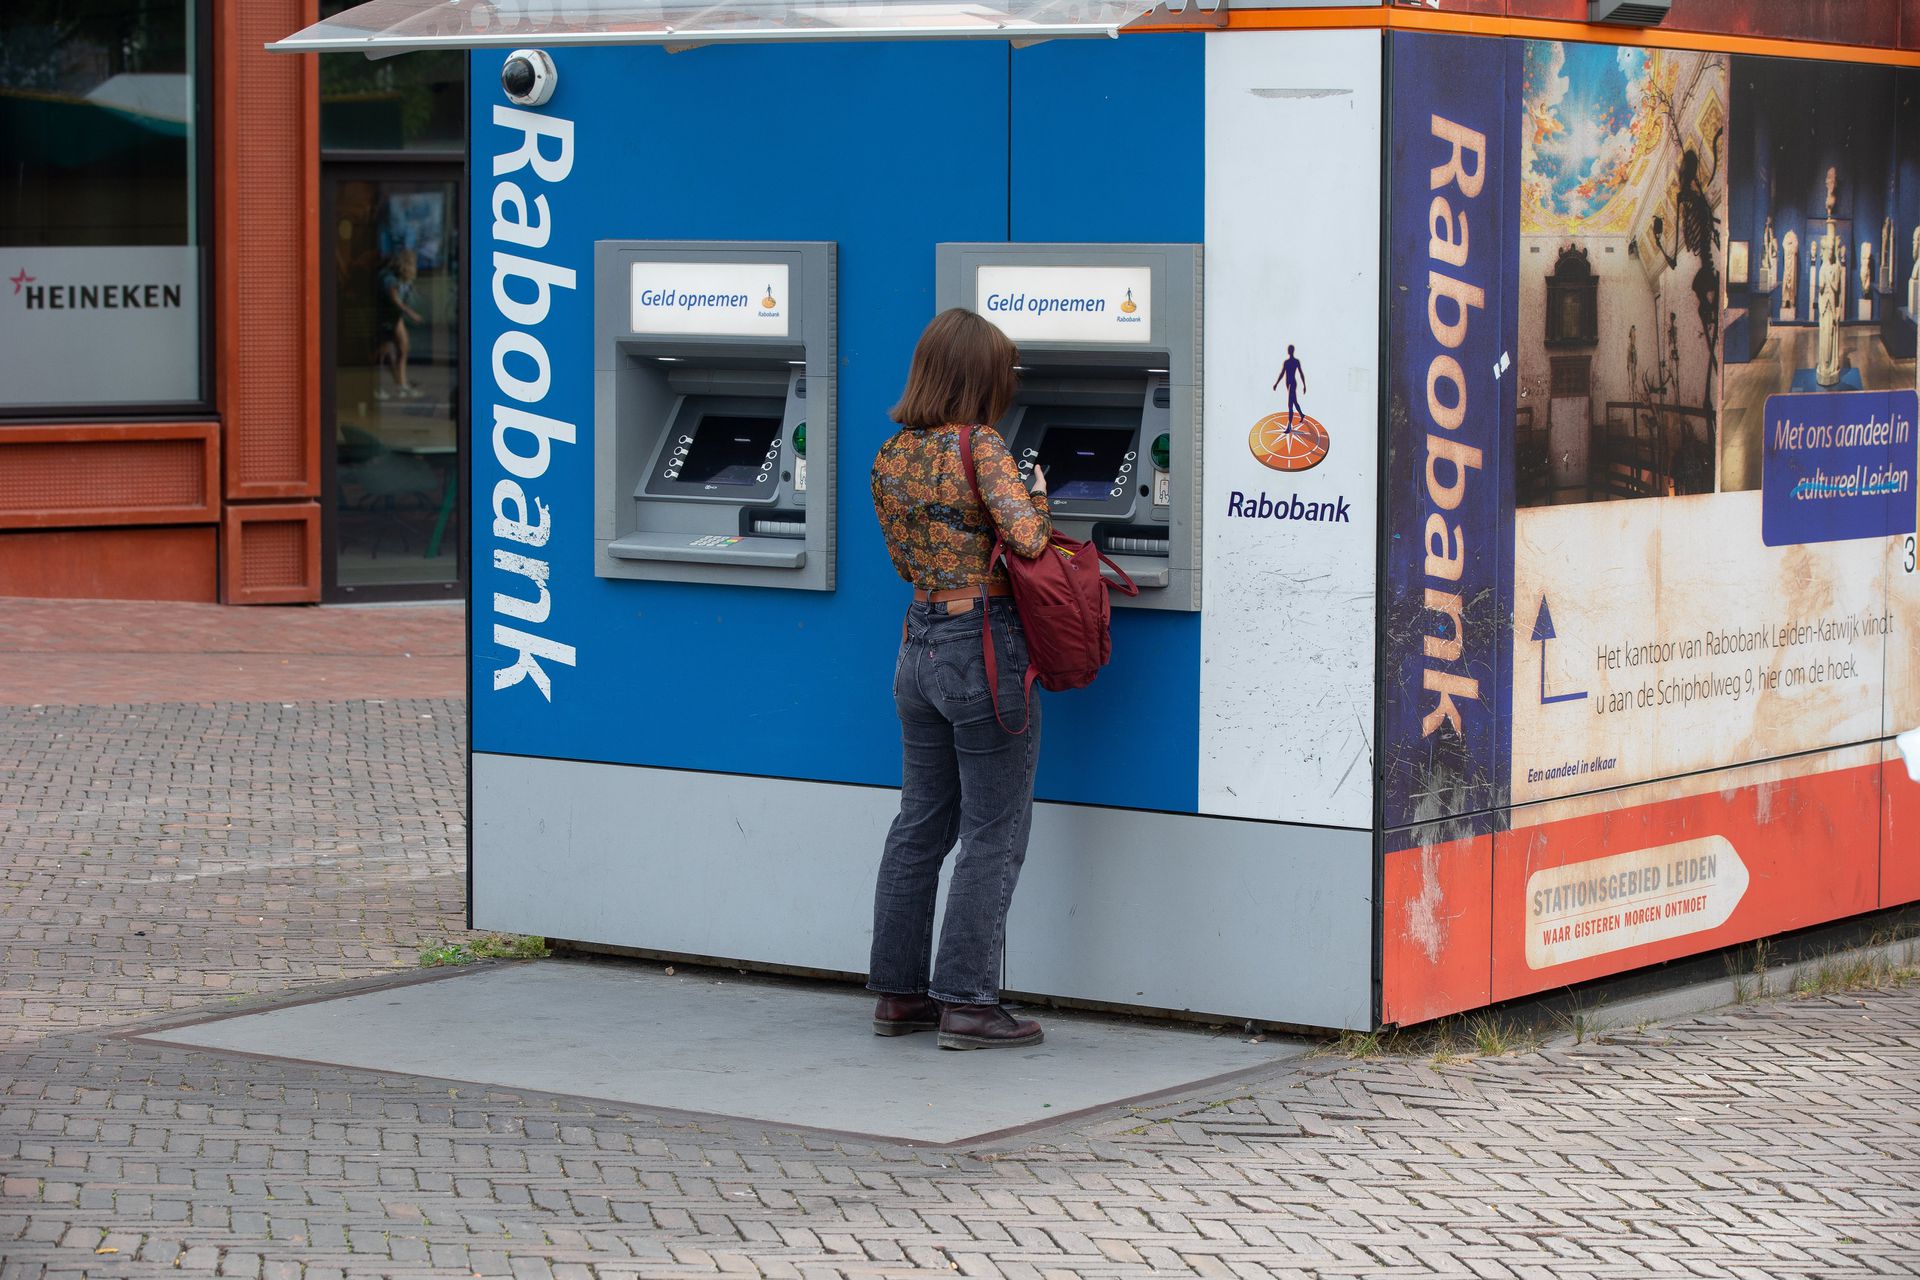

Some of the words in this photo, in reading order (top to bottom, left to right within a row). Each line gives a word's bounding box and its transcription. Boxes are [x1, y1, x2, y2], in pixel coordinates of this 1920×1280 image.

[26, 284, 182, 309] HEINEKEN
[641, 289, 676, 307] Geld
[678, 294, 748, 311] opnemen
[987, 293, 1025, 312] Geld
[1028, 298, 1106, 316] opnemen
[492, 104, 577, 703] Rabobank
[1421, 113, 1487, 738] Rabobank
[1774, 419, 1804, 450] Met
[1806, 424, 1833, 449] ons
[1835, 412, 1894, 448] aandeel
[1895, 413, 1909, 443] in
[1796, 464, 1860, 500] cultureel
[1861, 462, 1908, 496] Leiden
[1227, 491, 1350, 523] Rabobank
[1904, 536, 1916, 573] 3
[1597, 644, 1621, 671] Het
[1625, 640, 1676, 667] kantoor
[1679, 639, 1702, 659] van
[1706, 623, 1769, 657] Rabobank
[1772, 613, 1859, 648] Leiden-Katwijk
[1861, 609, 1894, 637] vindt
[1596, 695, 1605, 715] u
[1608, 690, 1633, 713] aan
[1637, 681, 1654, 708] de
[1656, 671, 1741, 708] Schipholweg
[1744, 668, 1755, 696] 9,
[1758, 664, 1782, 691] hier
[1784, 667, 1806, 687] om
[1808, 658, 1824, 684] de
[1827, 653, 1859, 681] hoek.
[1527, 768, 1544, 783] Een
[1545, 760, 1580, 780] aandeel
[1580, 759, 1589, 774] in
[1590, 757, 1617, 772] elkaar
[1533, 866, 1661, 917] STATIONSGEBIED
[1666, 853, 1717, 888] LEIDEN
[1542, 922, 1571, 946] WAAR
[1574, 914, 1620, 940] GISTEREN
[1624, 903, 1662, 928] MORGEN
[1664, 895, 1708, 919] ONTMOET
